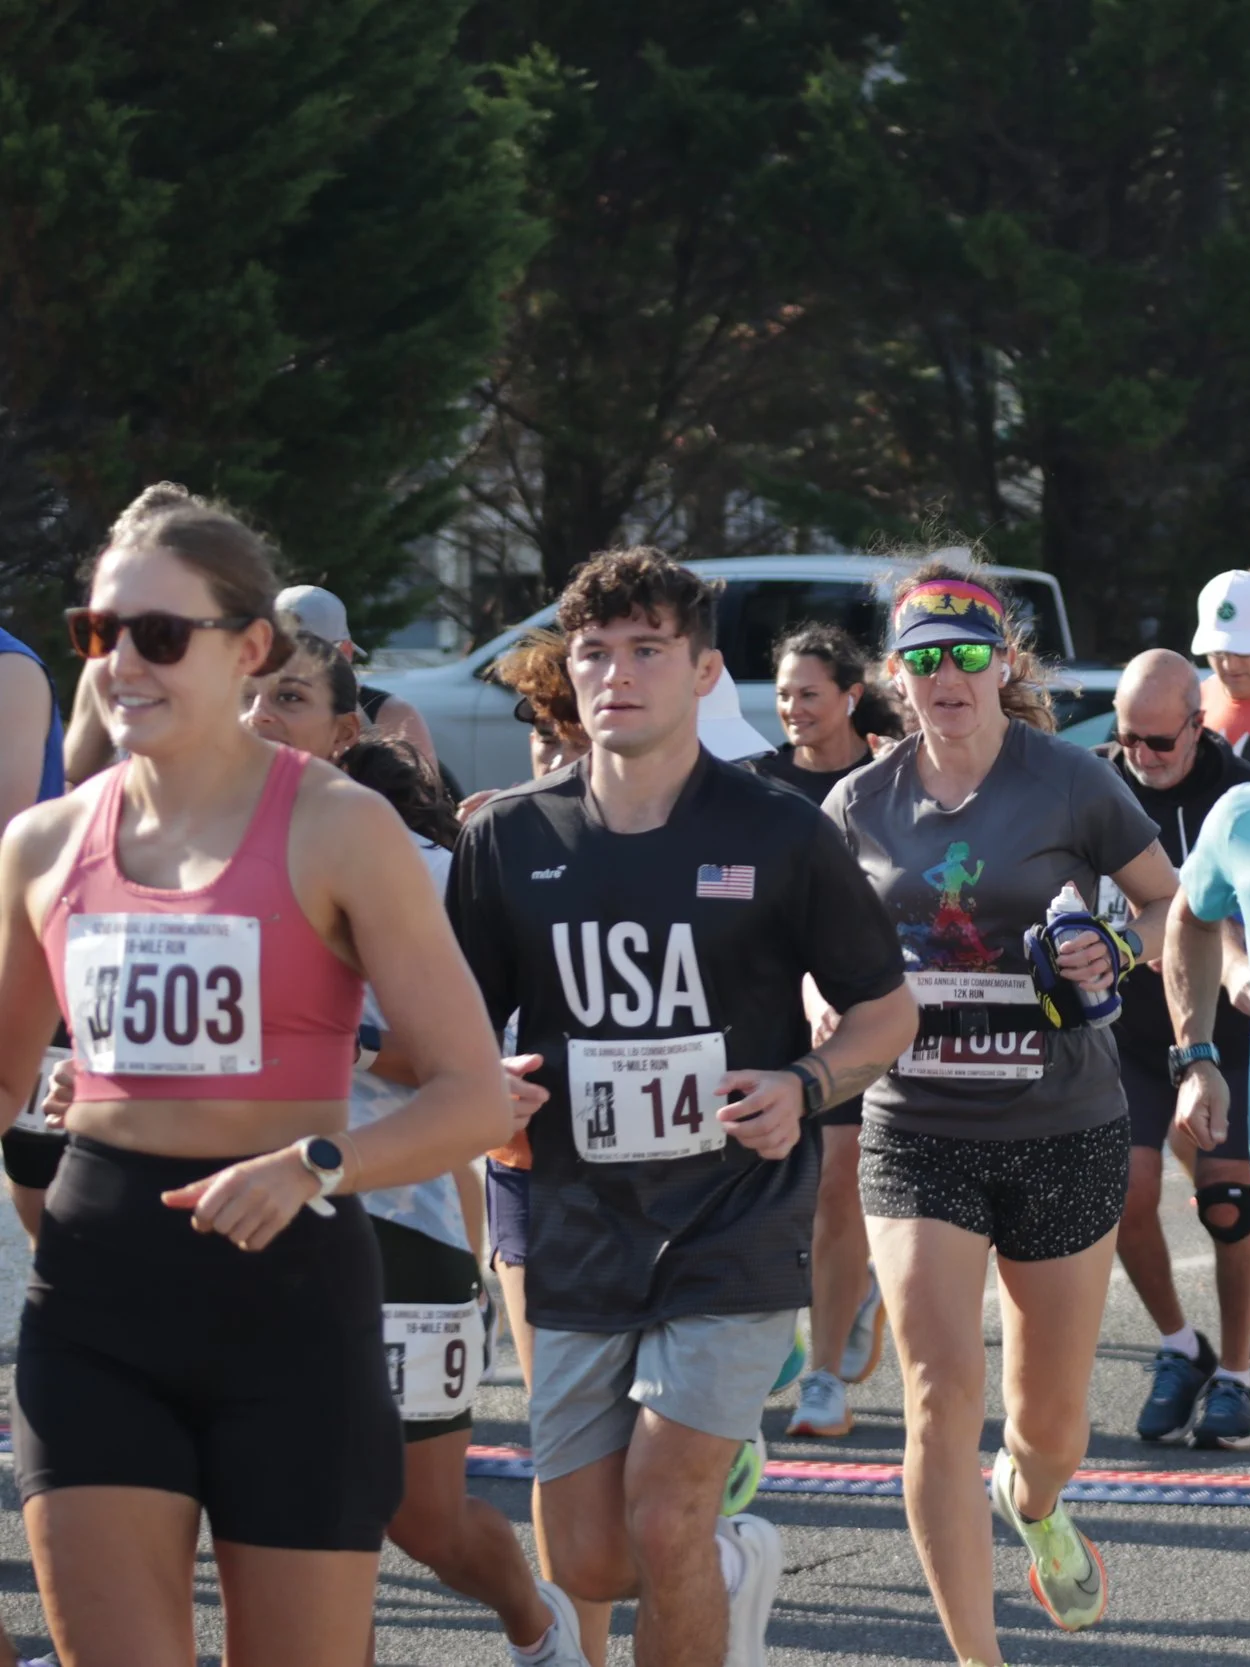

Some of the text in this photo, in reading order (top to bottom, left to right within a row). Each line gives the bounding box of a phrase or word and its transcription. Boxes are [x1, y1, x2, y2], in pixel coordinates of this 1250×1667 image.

[552, 921, 711, 1028] USA
[934, 977, 958, 987] ANNUAL
[959, 978, 970, 987] LBI
[971, 978, 1027, 989] COMMEMORATIVE
[123, 963, 245, 1046] 503
[953, 989, 985, 999] 12K RUN
[612, 1059, 669, 1072] 18-MILE RUN
[641, 1073, 704, 1138] 14
[443, 1322, 461, 1334] RUN
[444, 1339, 467, 1399] 9
